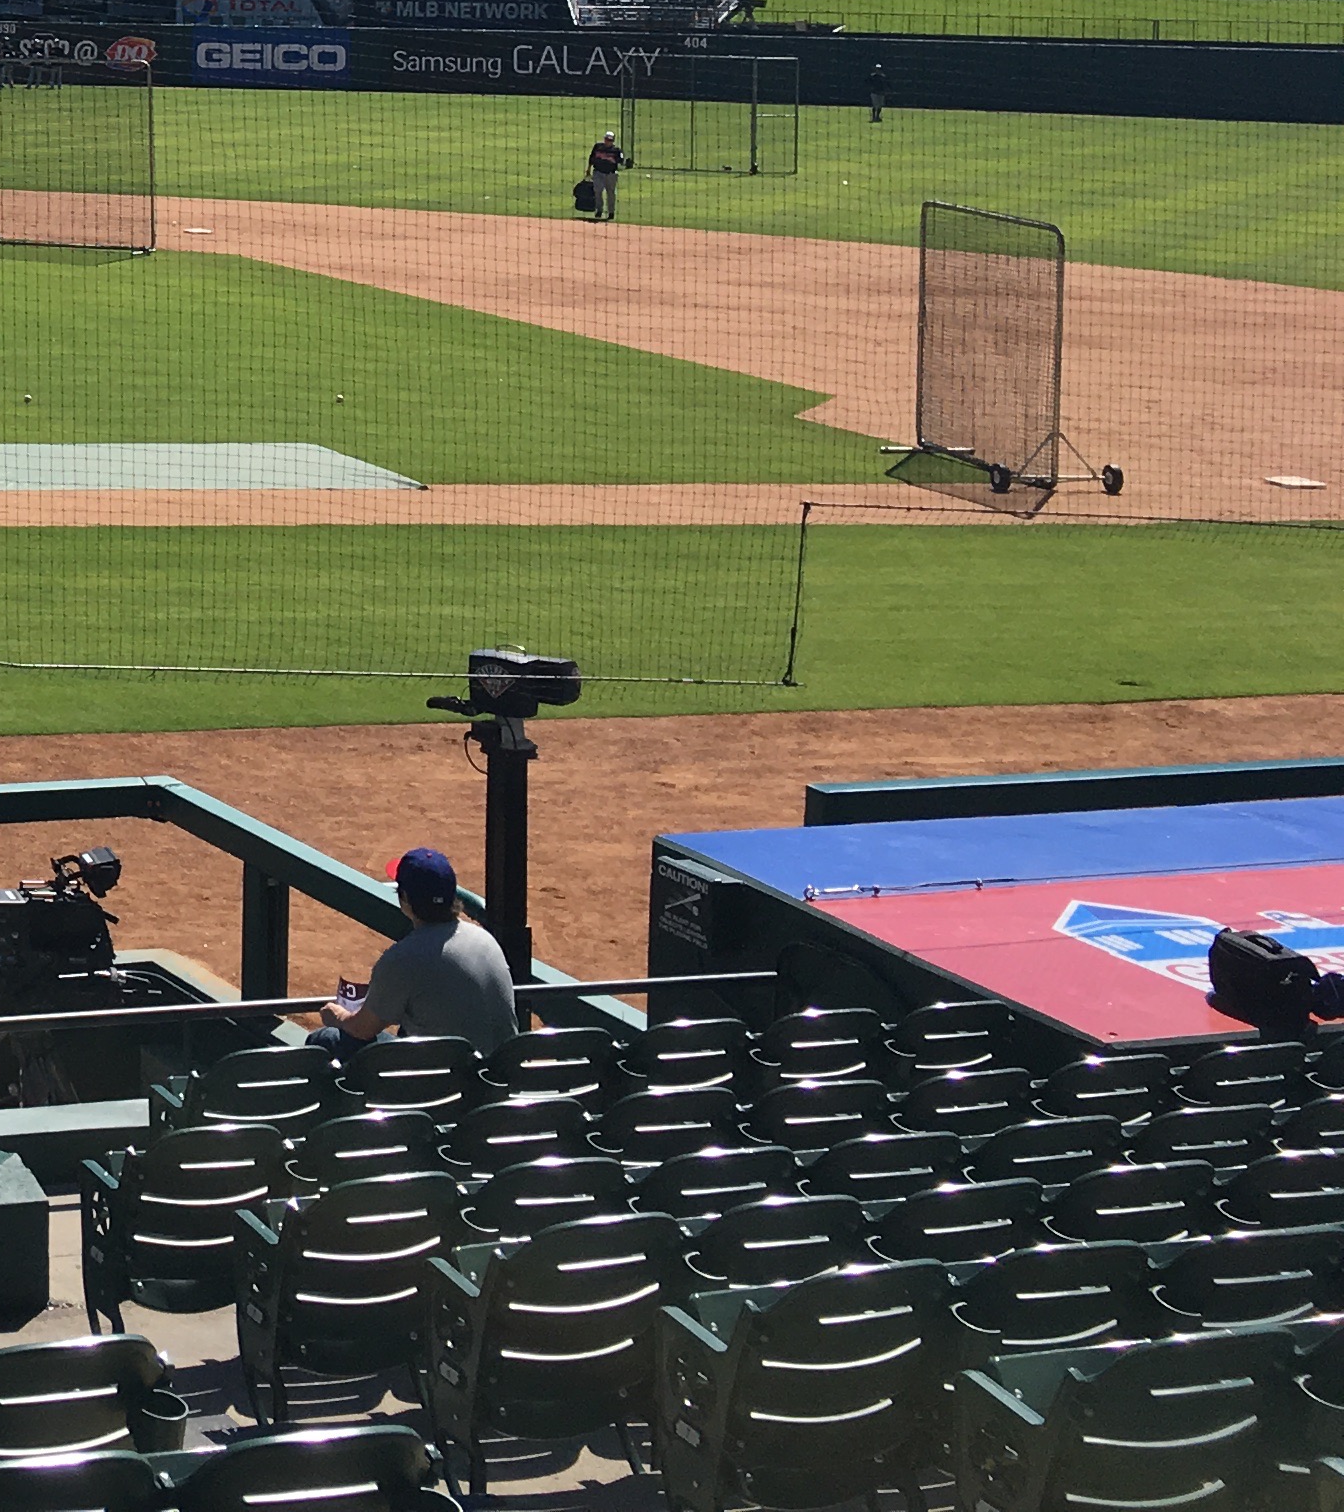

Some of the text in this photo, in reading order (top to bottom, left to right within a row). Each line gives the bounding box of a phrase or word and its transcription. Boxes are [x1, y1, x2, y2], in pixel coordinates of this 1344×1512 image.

[396, 1, 549, 20] MLB NETWORK
[197, 43, 346, 71] GEICO
[684, 37, 708, 49] 404
[393, 45, 661, 78] Samsung GALAXY
[658, 864, 709, 895] CAUTION!
